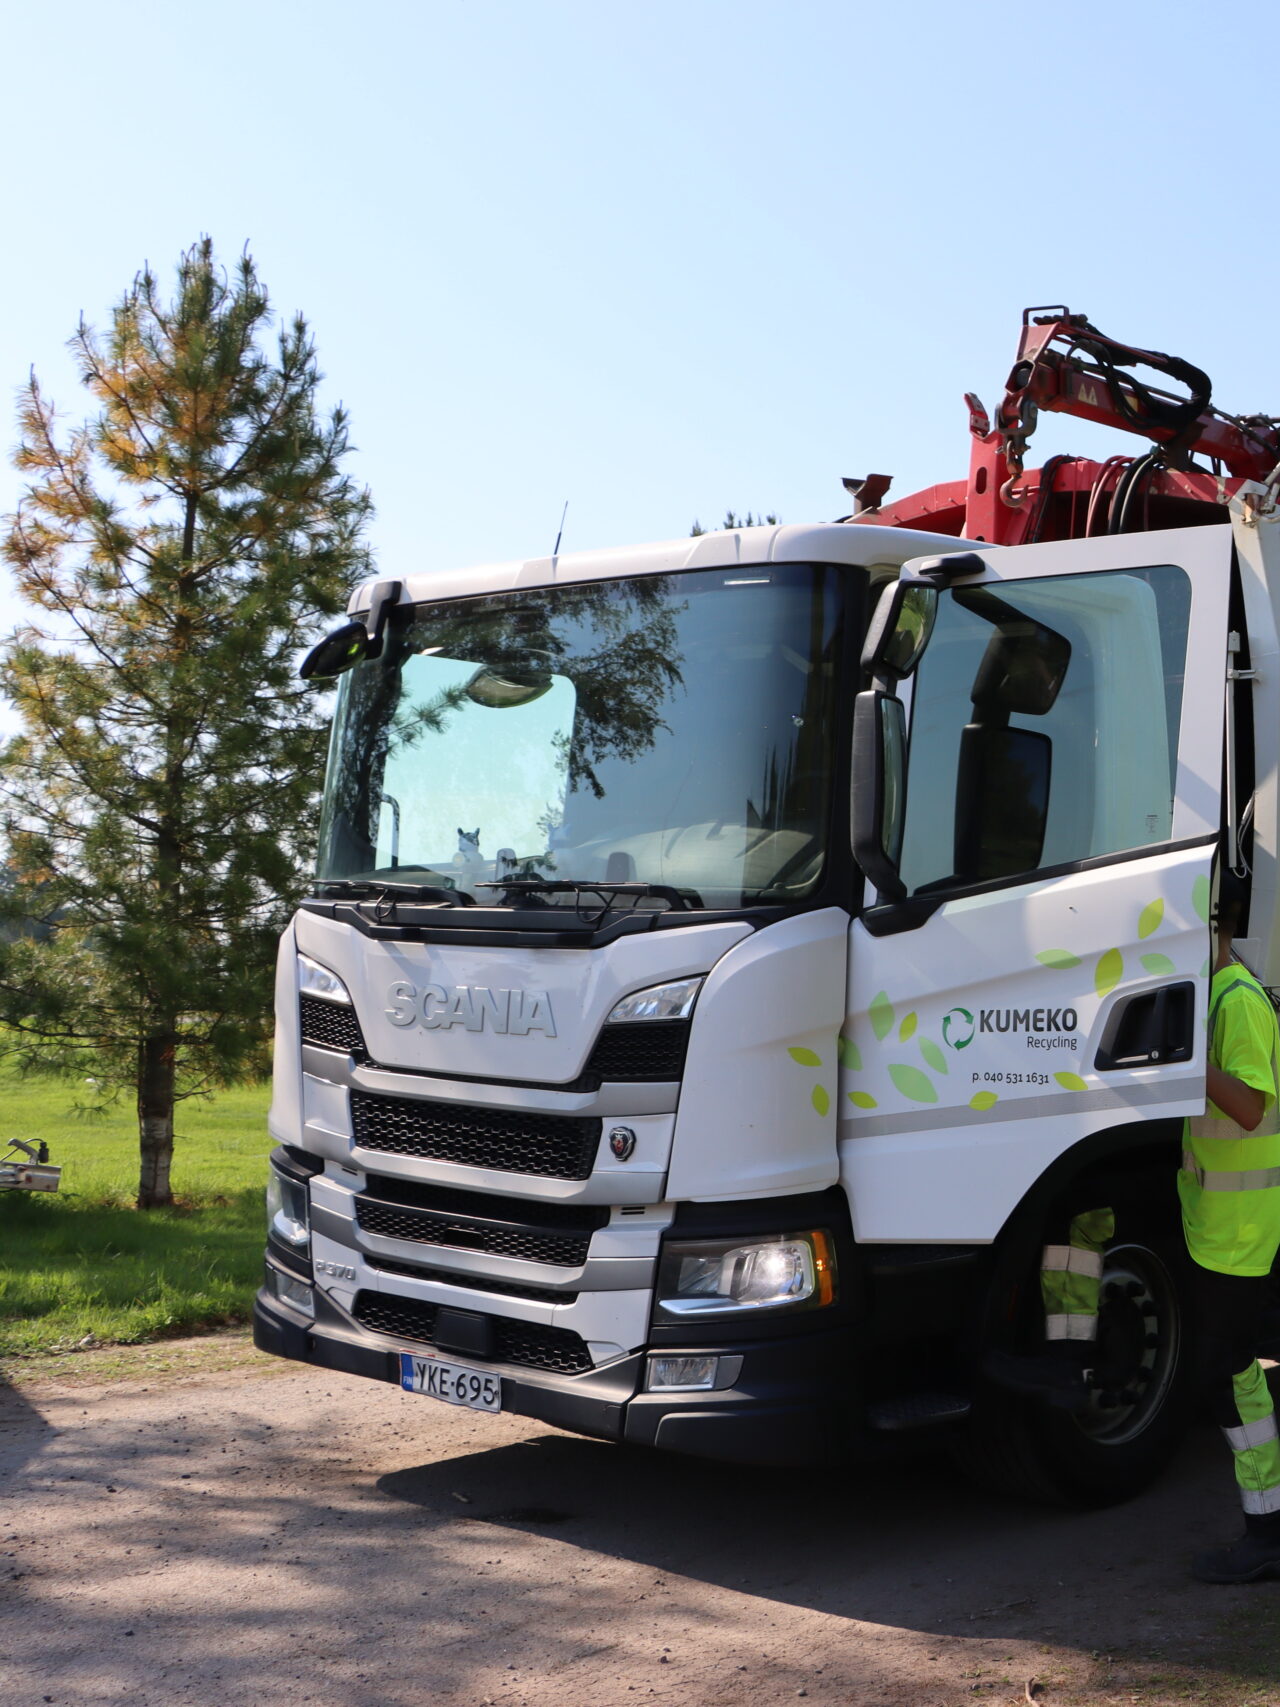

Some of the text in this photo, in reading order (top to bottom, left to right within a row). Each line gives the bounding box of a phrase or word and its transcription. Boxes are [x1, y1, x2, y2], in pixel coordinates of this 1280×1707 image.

[385, 981, 557, 1038] SCANIA
[980, 1008, 1078, 1033] KUMEKO
[1027, 1036, 1077, 1051] Recycling
[984, 1072, 1003, 1083] 040
[1006, 1073, 1023, 1084] 531
[1026, 1072, 1049, 1085] 1631
[416, 1362, 496, 1406] YKE-695
